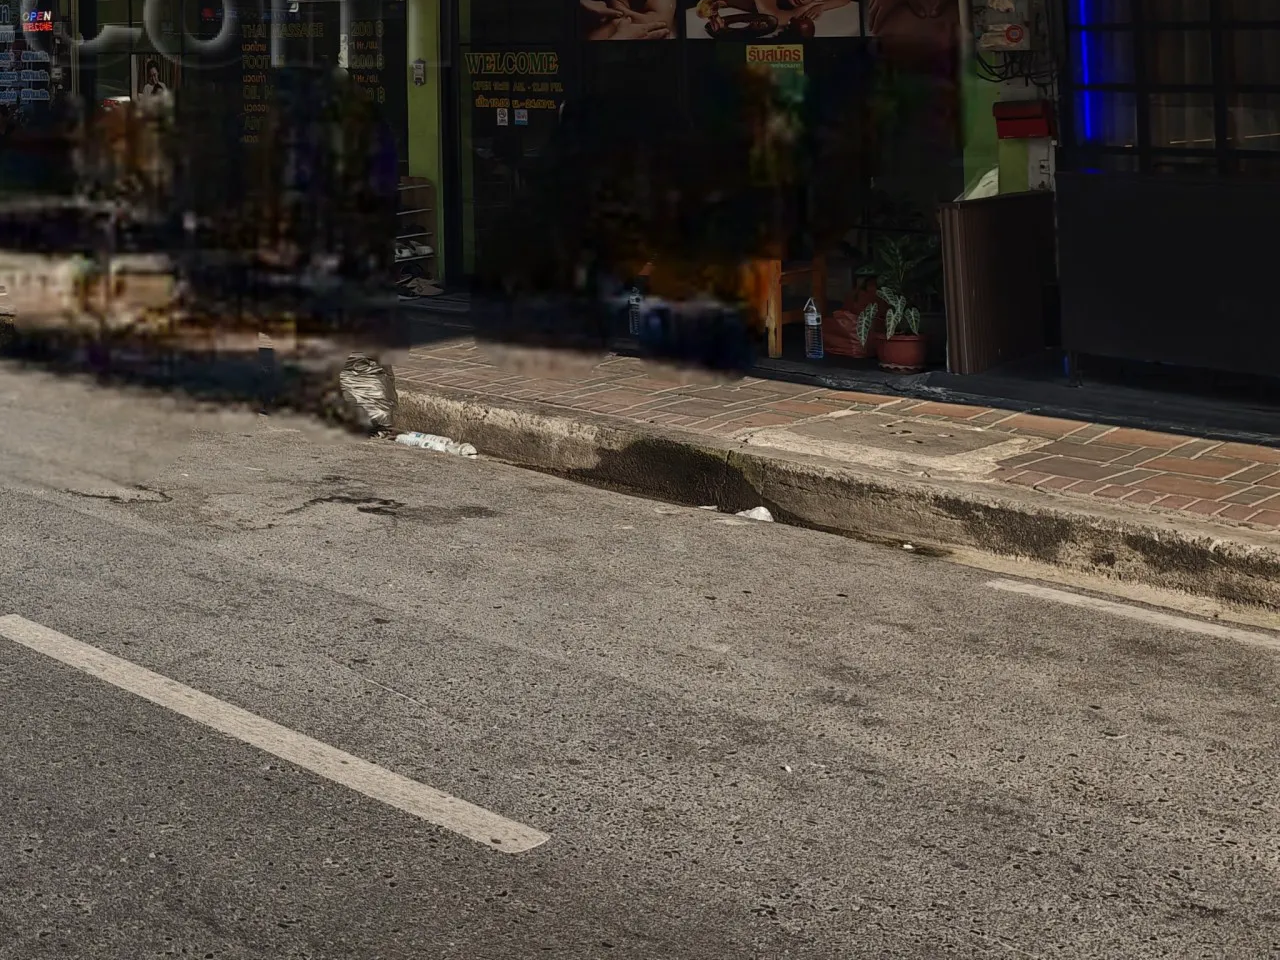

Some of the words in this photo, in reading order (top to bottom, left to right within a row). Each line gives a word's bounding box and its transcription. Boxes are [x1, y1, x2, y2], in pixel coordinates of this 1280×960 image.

[22, 10, 52, 21] OPEN
[241, 23, 267, 39] THAI
[748, 46, 801, 62] รับสมัคร
[464, 51, 560, 75] WELCOME
